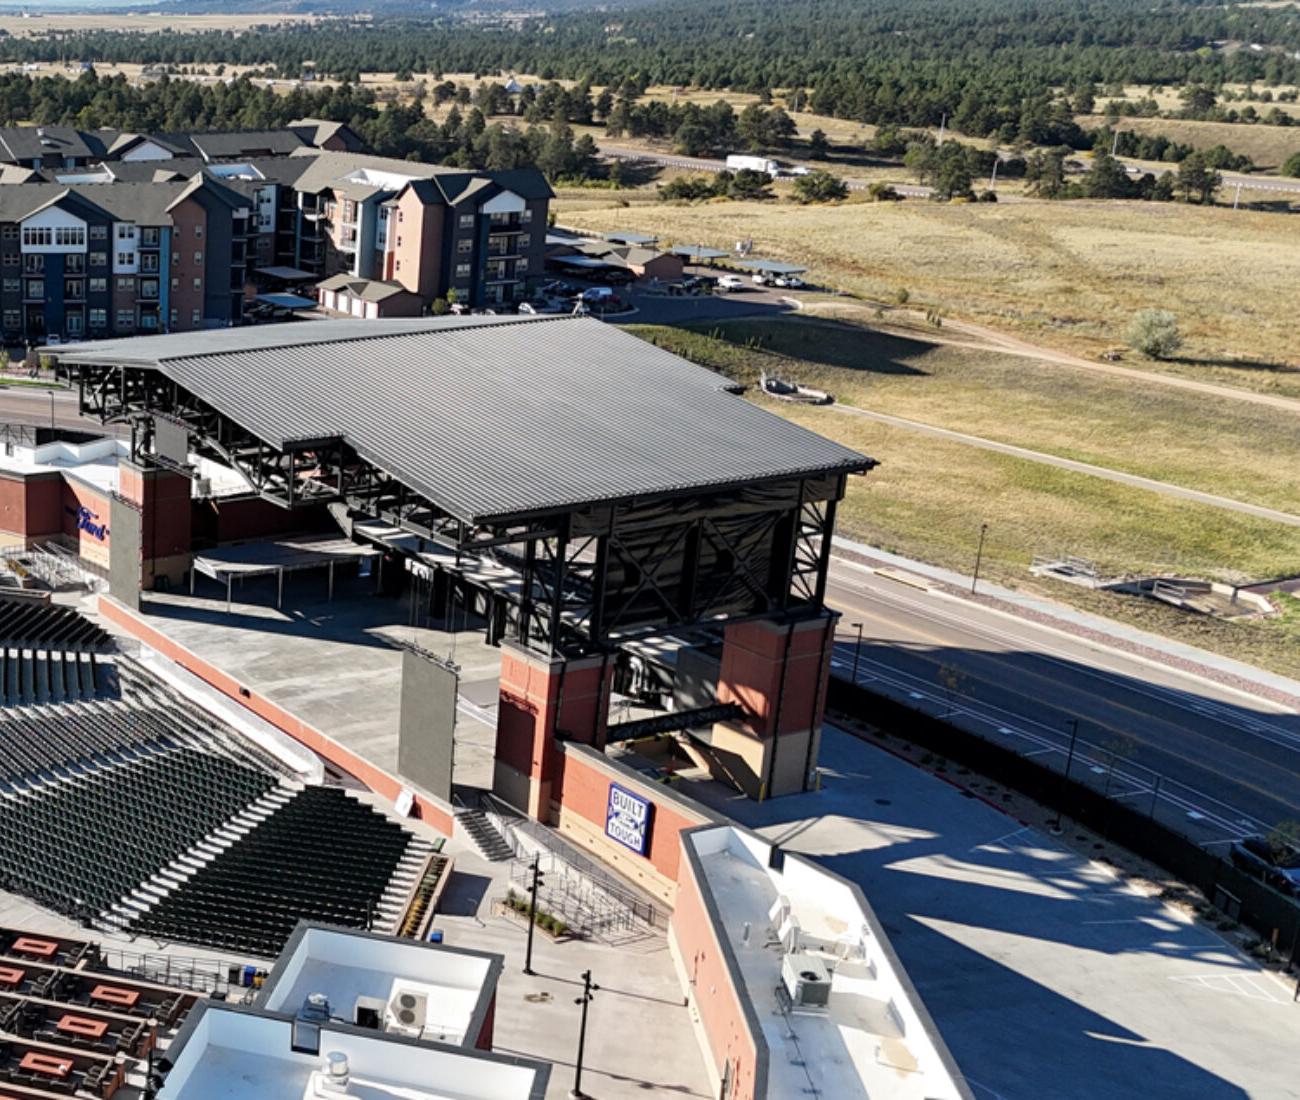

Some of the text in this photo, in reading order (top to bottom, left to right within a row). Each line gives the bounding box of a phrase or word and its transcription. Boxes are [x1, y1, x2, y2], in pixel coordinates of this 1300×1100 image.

[65, 505, 110, 541] Ford
[613, 791, 643, 817] BUILT
[610, 822, 640, 845] TOUGH
